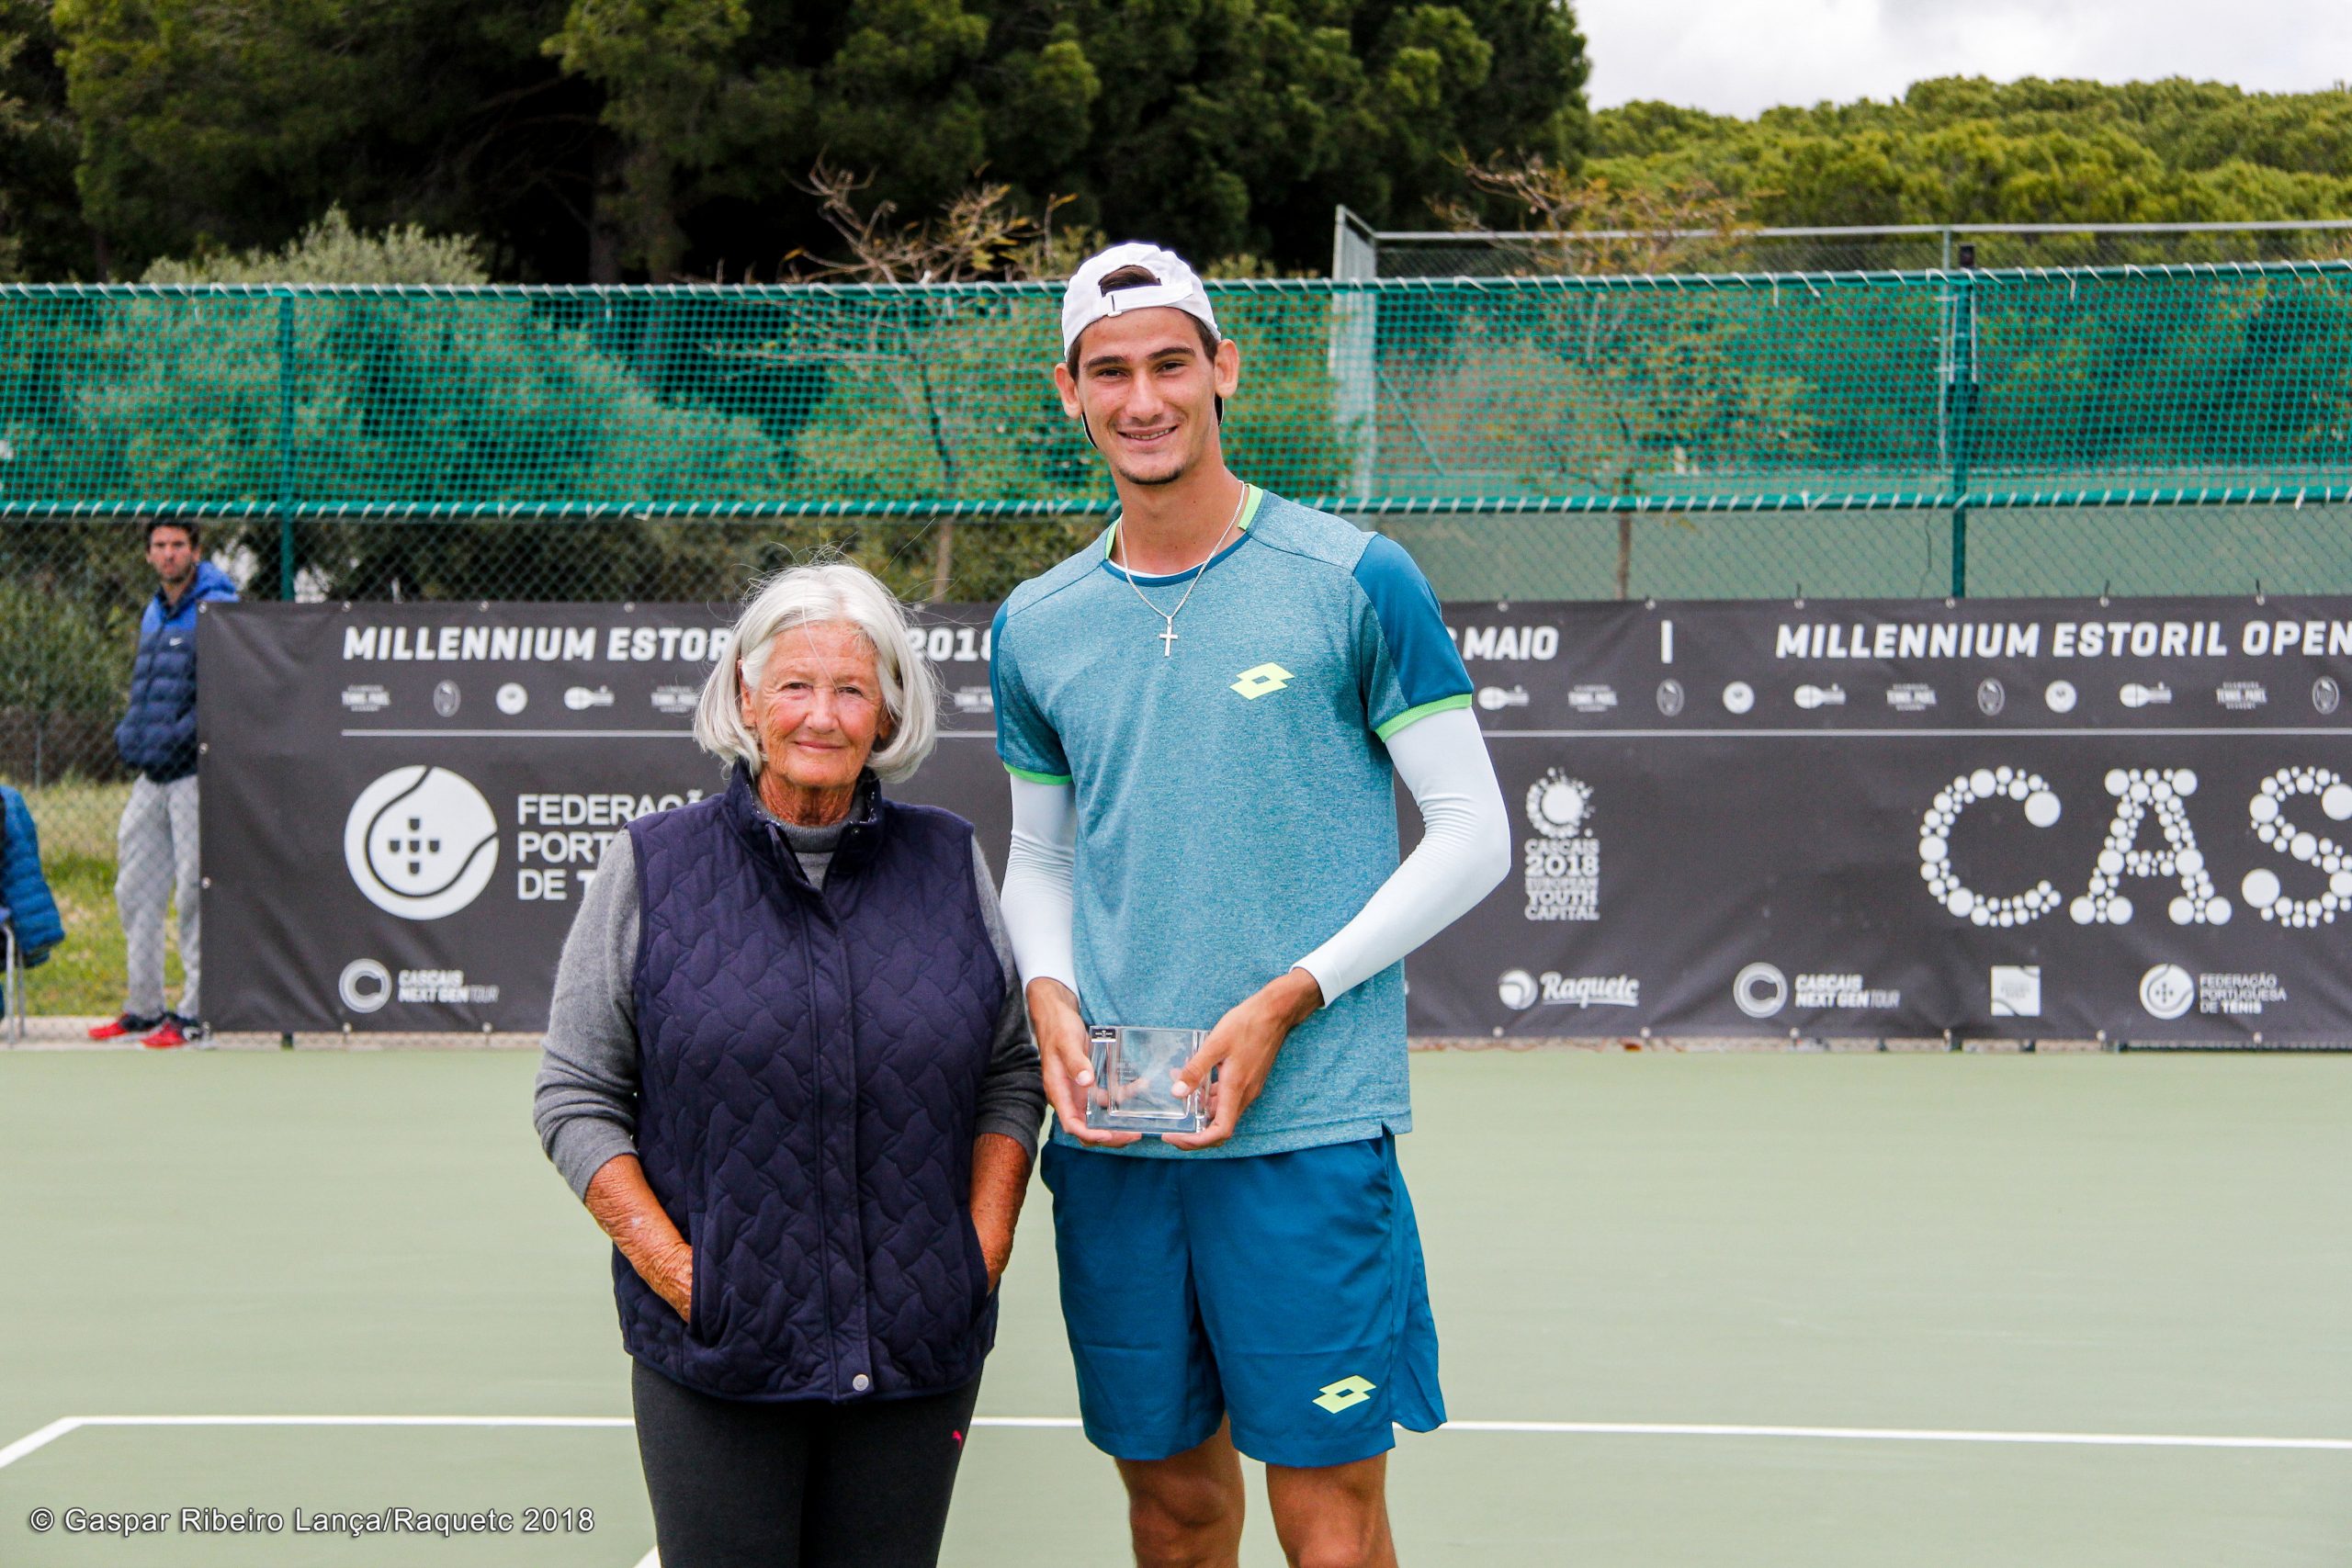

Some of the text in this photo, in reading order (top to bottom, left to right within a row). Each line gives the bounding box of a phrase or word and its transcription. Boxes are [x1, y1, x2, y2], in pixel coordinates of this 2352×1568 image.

[343, 626, 597, 661] MILLENNIUM
[606, 626, 734, 662] ESTOR
[1462, 626, 1559, 660] MAIO
[1775, 620, 2352, 660] MILLENNIUM ESTORIL OPEN
[1524, 838, 1600, 855] CASCAIS
[1918, 765, 2352, 929] CAS
[1524, 855, 1600, 877] 2018
[517, 868, 568, 901] DE
[1540, 971, 1640, 1009] Raquetc
[2199, 1000, 2218, 1013] DE
